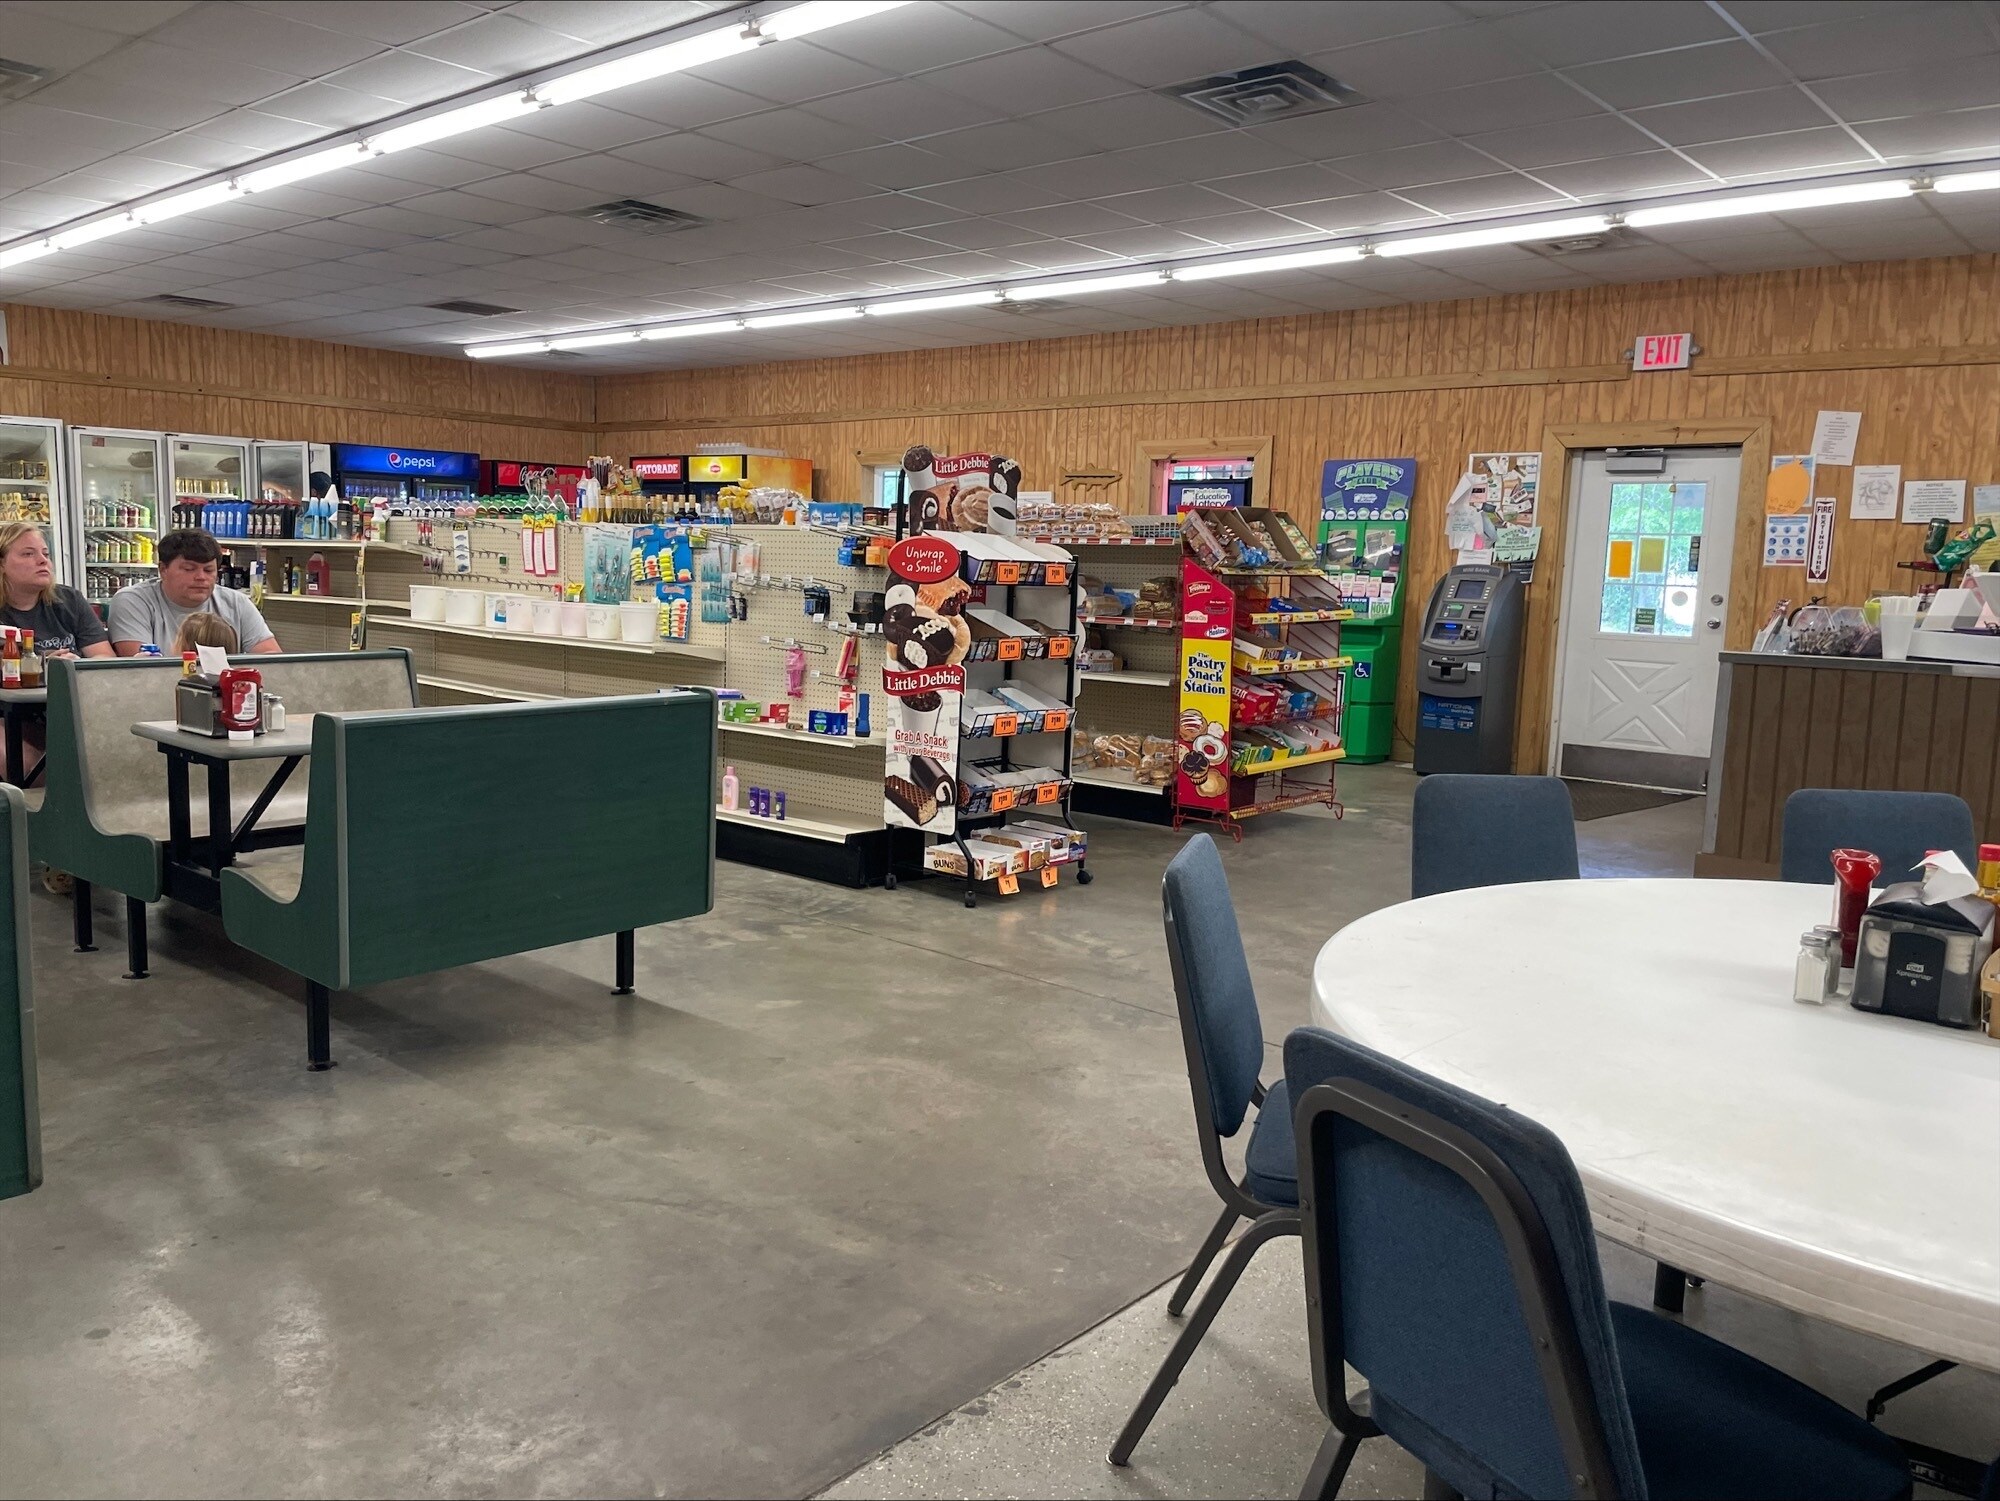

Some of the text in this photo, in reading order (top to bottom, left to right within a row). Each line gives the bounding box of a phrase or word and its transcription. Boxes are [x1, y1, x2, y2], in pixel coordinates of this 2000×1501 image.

[1643, 335, 1684, 366] EXIT
[403, 457, 436, 469] pepsi
[636, 464, 678, 474] GATORADE
[935, 456, 989, 474] Little Debbie
[1817, 505, 1833, 514] FIRE
[1815, 514, 1827, 575] EXTINGUISHER
[906, 546, 945, 563] Unwrap
[906, 560, 942, 573] a Smile
[1371, 604, 1390, 613] NOW
[1188, 656, 1226, 671] Pastry
[886, 670, 961, 691] Little Debbie
[1188, 668, 1222, 682] Snack
[1184, 680, 1226, 695] Station
[895, 729, 948, 748] Grab A Snack
[893, 743, 951, 762] with your Beverage
[933, 859, 955, 870] BUNS
[987, 865, 1000, 877] BUNS
[1011, 861, 1024, 872] BUNS
